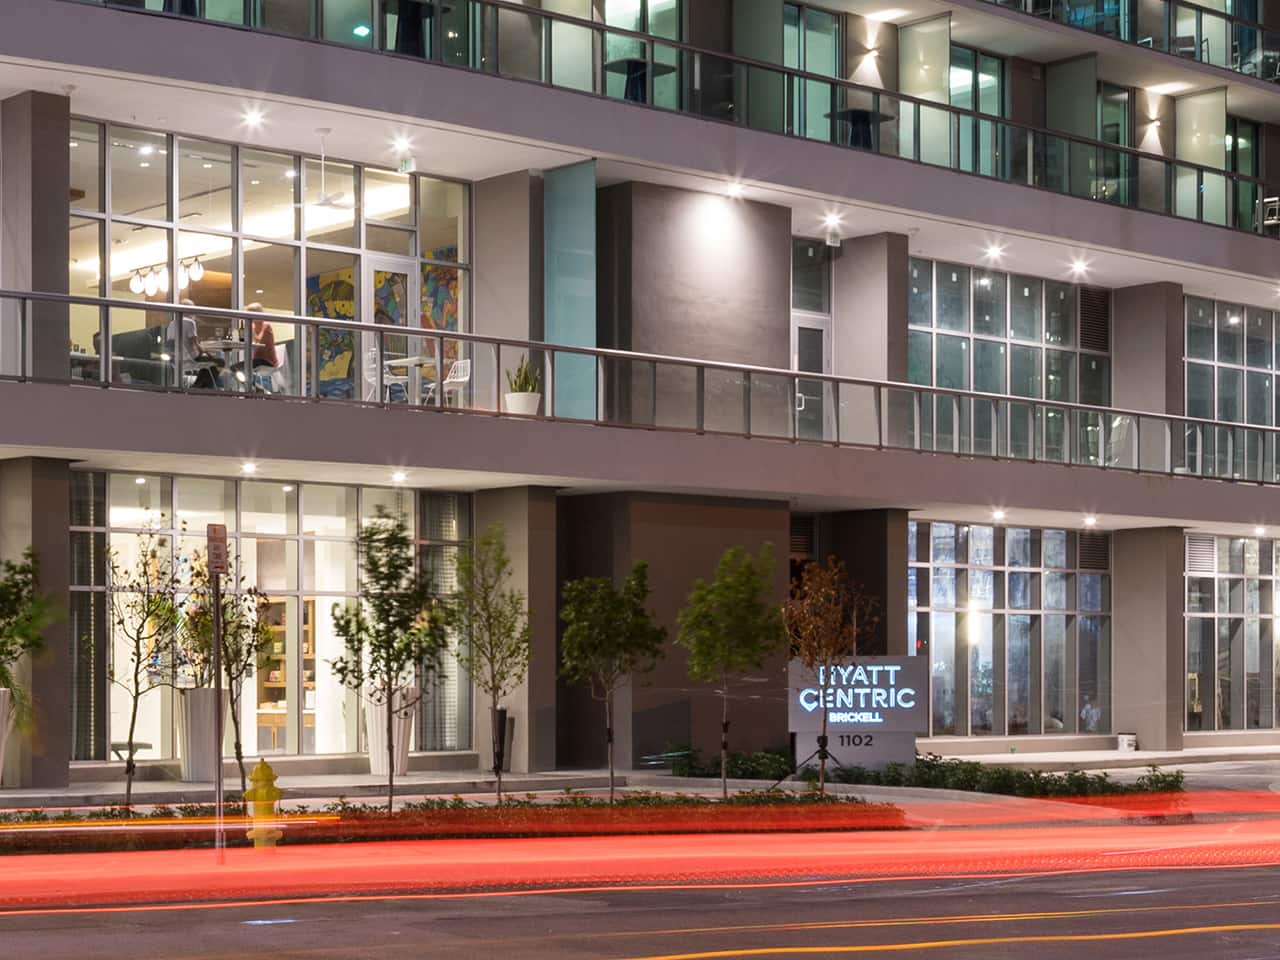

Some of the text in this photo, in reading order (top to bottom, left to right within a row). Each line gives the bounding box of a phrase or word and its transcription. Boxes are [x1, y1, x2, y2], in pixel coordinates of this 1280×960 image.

[819, 665, 902, 686] HYATT
[800, 687, 916, 713] CENTRIC
[828, 711, 884, 723] BRICKELL
[838, 734, 873, 747] 1102
